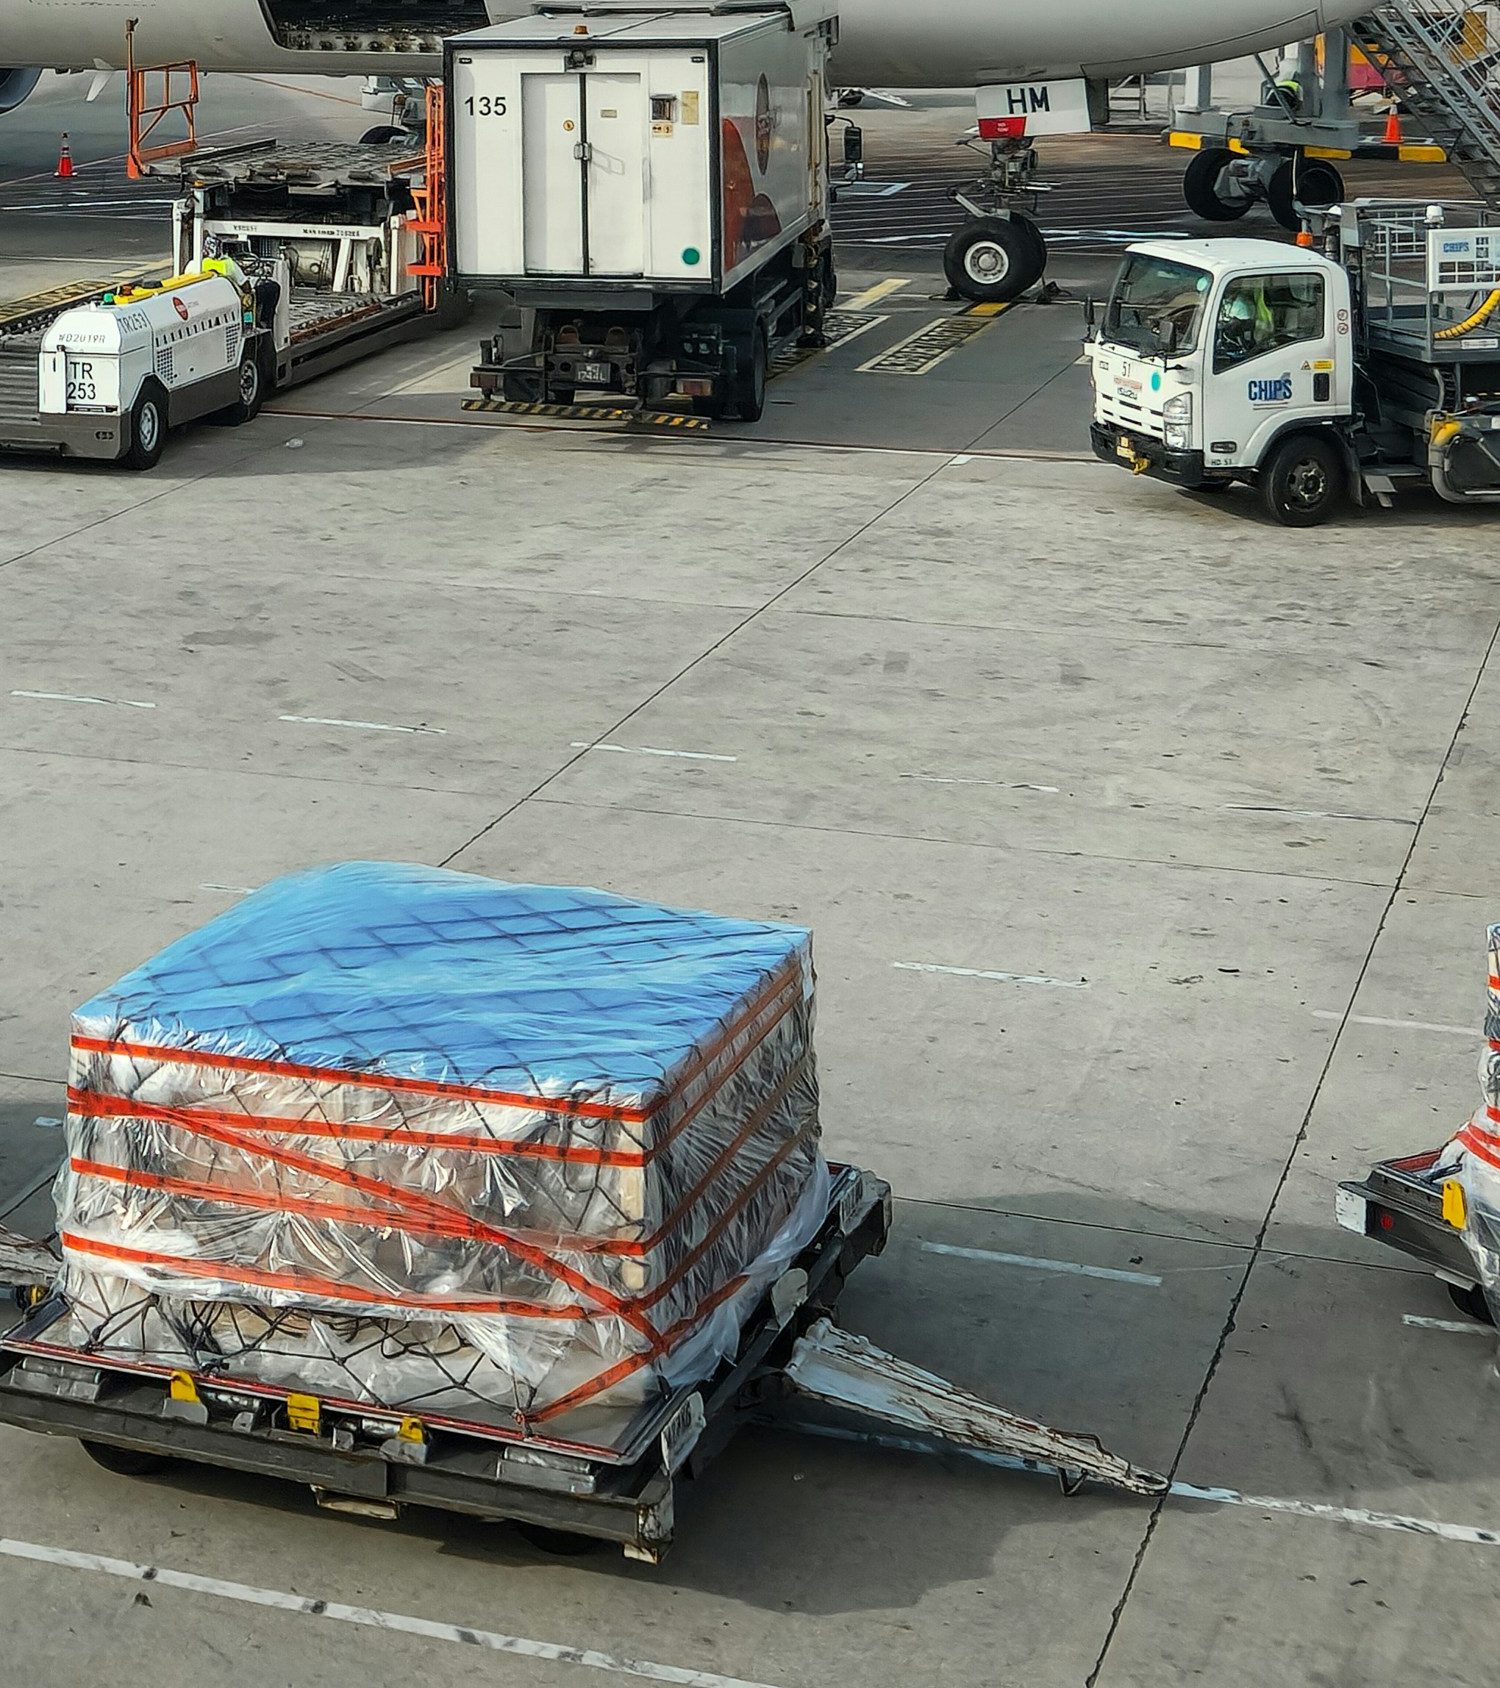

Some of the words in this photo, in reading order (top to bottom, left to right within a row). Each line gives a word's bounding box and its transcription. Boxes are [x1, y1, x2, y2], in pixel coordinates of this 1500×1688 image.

[463, 96, 507, 117] 135
[1006, 86, 1051, 114] HM
[1442, 241, 1470, 253] CHIPS
[118, 313, 147, 335] TR253
[69, 361, 94, 381] TR
[1122, 361, 1131, 377] 51
[68, 383, 97, 400] 253
[1248, 378, 1293, 402] CHIPS
